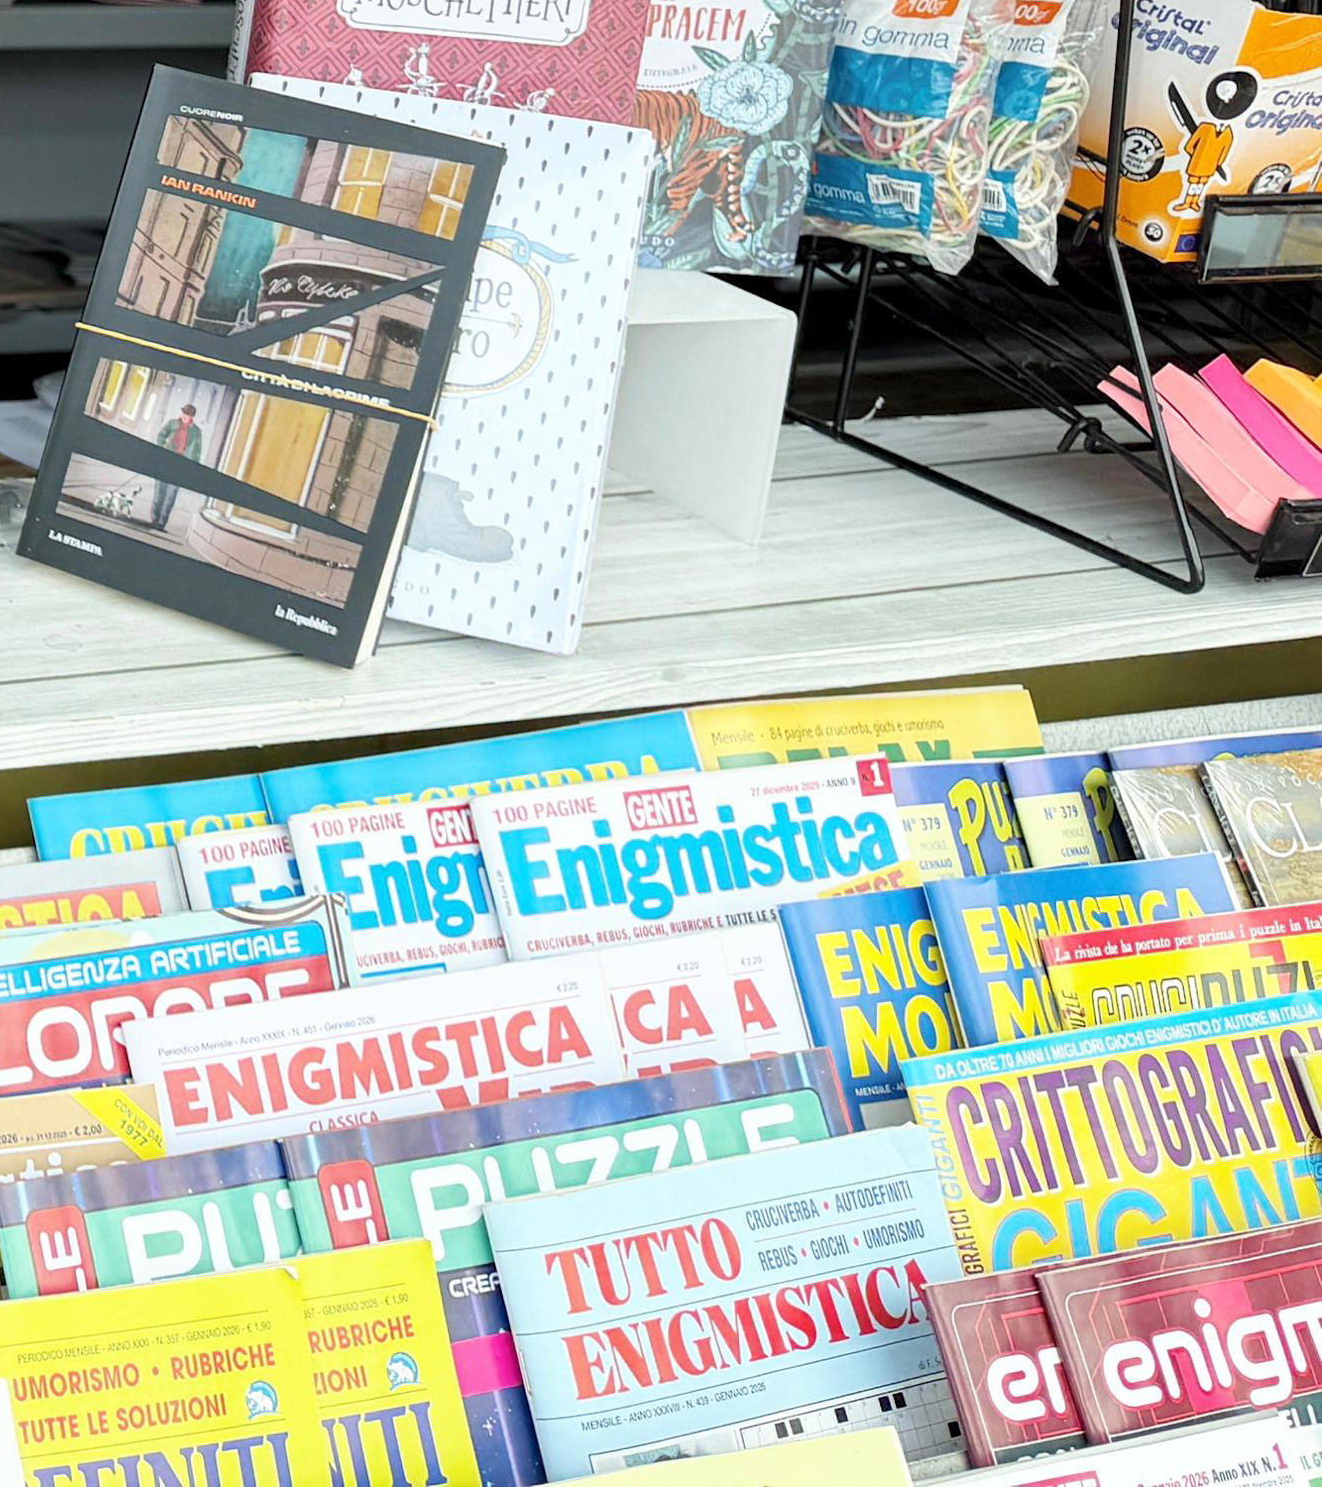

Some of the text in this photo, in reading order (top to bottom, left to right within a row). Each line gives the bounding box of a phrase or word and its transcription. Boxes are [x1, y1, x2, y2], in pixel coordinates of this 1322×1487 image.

[180, 105, 243, 122] CUORENOIR
[161, 176, 256, 209] IAN RANKIN
[493, 786, 697, 828] 100 PAGINE GENTE
[501, 796, 898, 921] Enigmistica
[150, 930, 301, 975] ARTIFICIALE
[164, 1005, 591, 1127] ENIGMISTICA
[935, 1062, 953, 1079] DA
[957, 1057, 994, 1076] OLTRE
[997, 1054, 1011, 1070] 70
[1015, 1048, 1044, 1068] ANNI
[1052, 1037, 1104, 1062] MIGLIORI
[1106, 1031, 1145, 1053] GIOCHI
[1146, 1021, 1211, 1045] ENIGMISTICI
[1269, 1007, 1280, 1023] IN
[1281, 1003, 1317, 1021] ITALIA
[545, 1179, 913, 1314] TUTTO CRUCIVERBA AUTODEFINITI
[758, 1218, 925, 1270] REBUS GIOCHI UMORISMO
[310, 1315, 415, 1354] RUBRICHE
[563, 1258, 928, 1401] ENIGMISTICA
[13, 1343, 275, 1401] UMORISMO RUBRICHE
[19, 1393, 227, 1444] TUTTE LE SOLUZIONI
